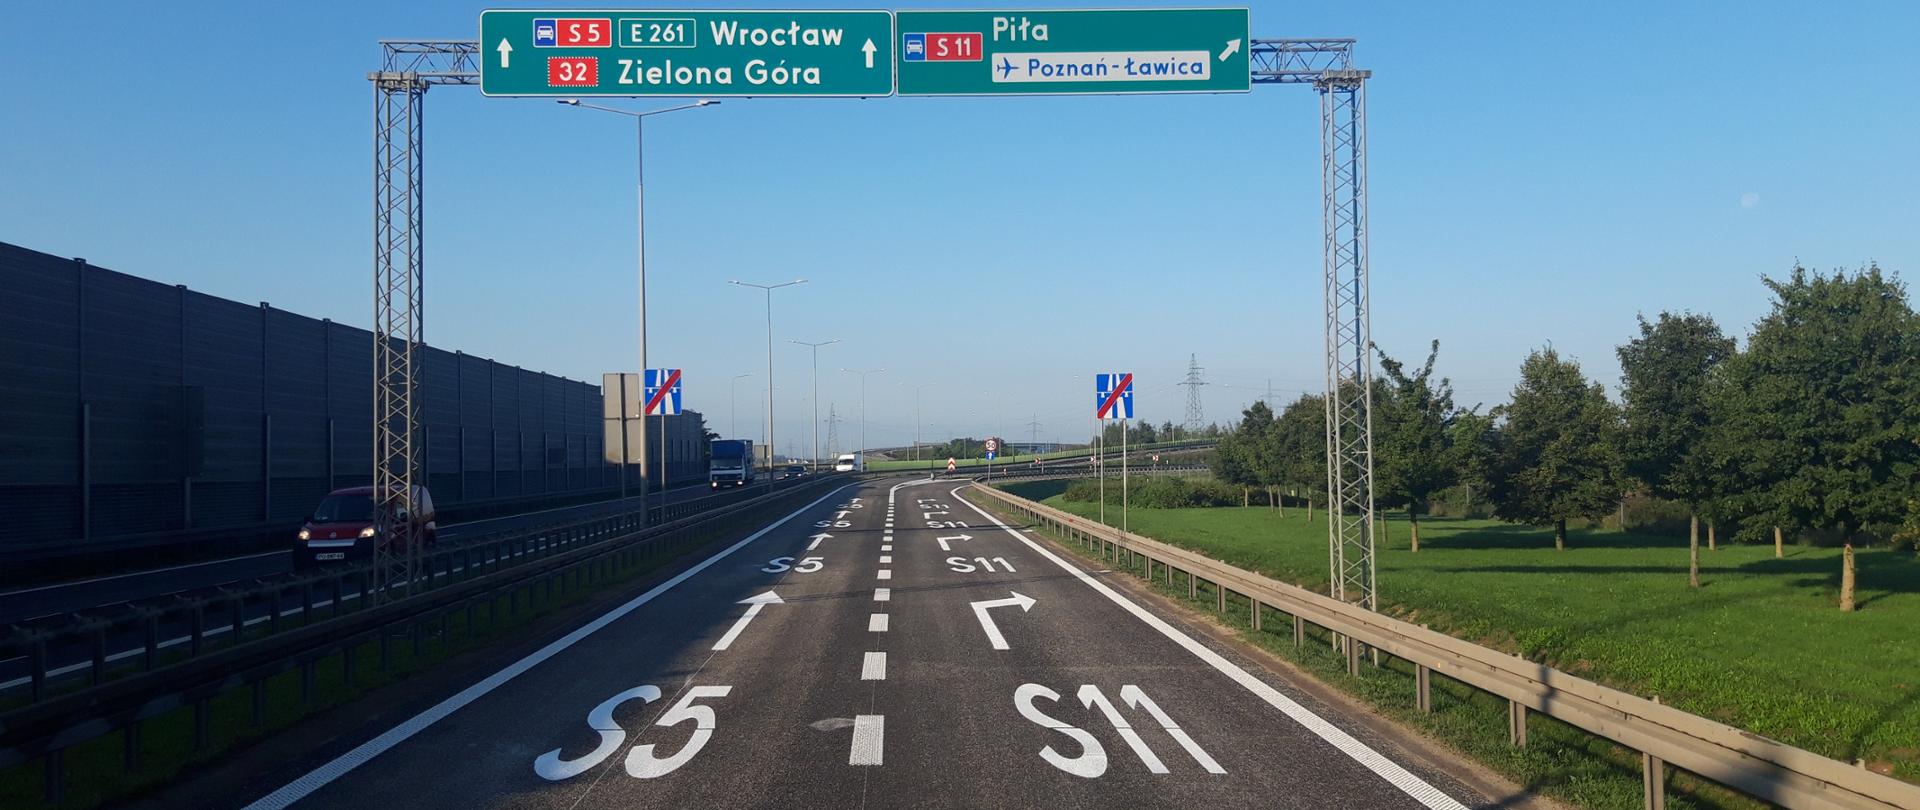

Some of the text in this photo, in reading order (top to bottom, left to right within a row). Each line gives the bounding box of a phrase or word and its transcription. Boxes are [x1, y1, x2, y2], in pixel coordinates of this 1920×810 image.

[569, 24, 600, 43] S 5
[632, 24, 685, 43] E 261
[710, 21, 844, 46] Wrocław
[993, 17, 1049, 41] Piła
[937, 38, 971, 57] S 11
[559, 63, 587, 82] 32
[618, 59, 821, 85] Zielona Góra
[1028, 57, 1204, 78] Poznań-Ławica
[814, 520, 852, 528] S5
[926, 520, 969, 529] S11
[761, 556, 825, 573] S5
[945, 556, 1017, 573] S11
[533, 684, 734, 781] S5
[1013, 683, 1229, 779] S11
